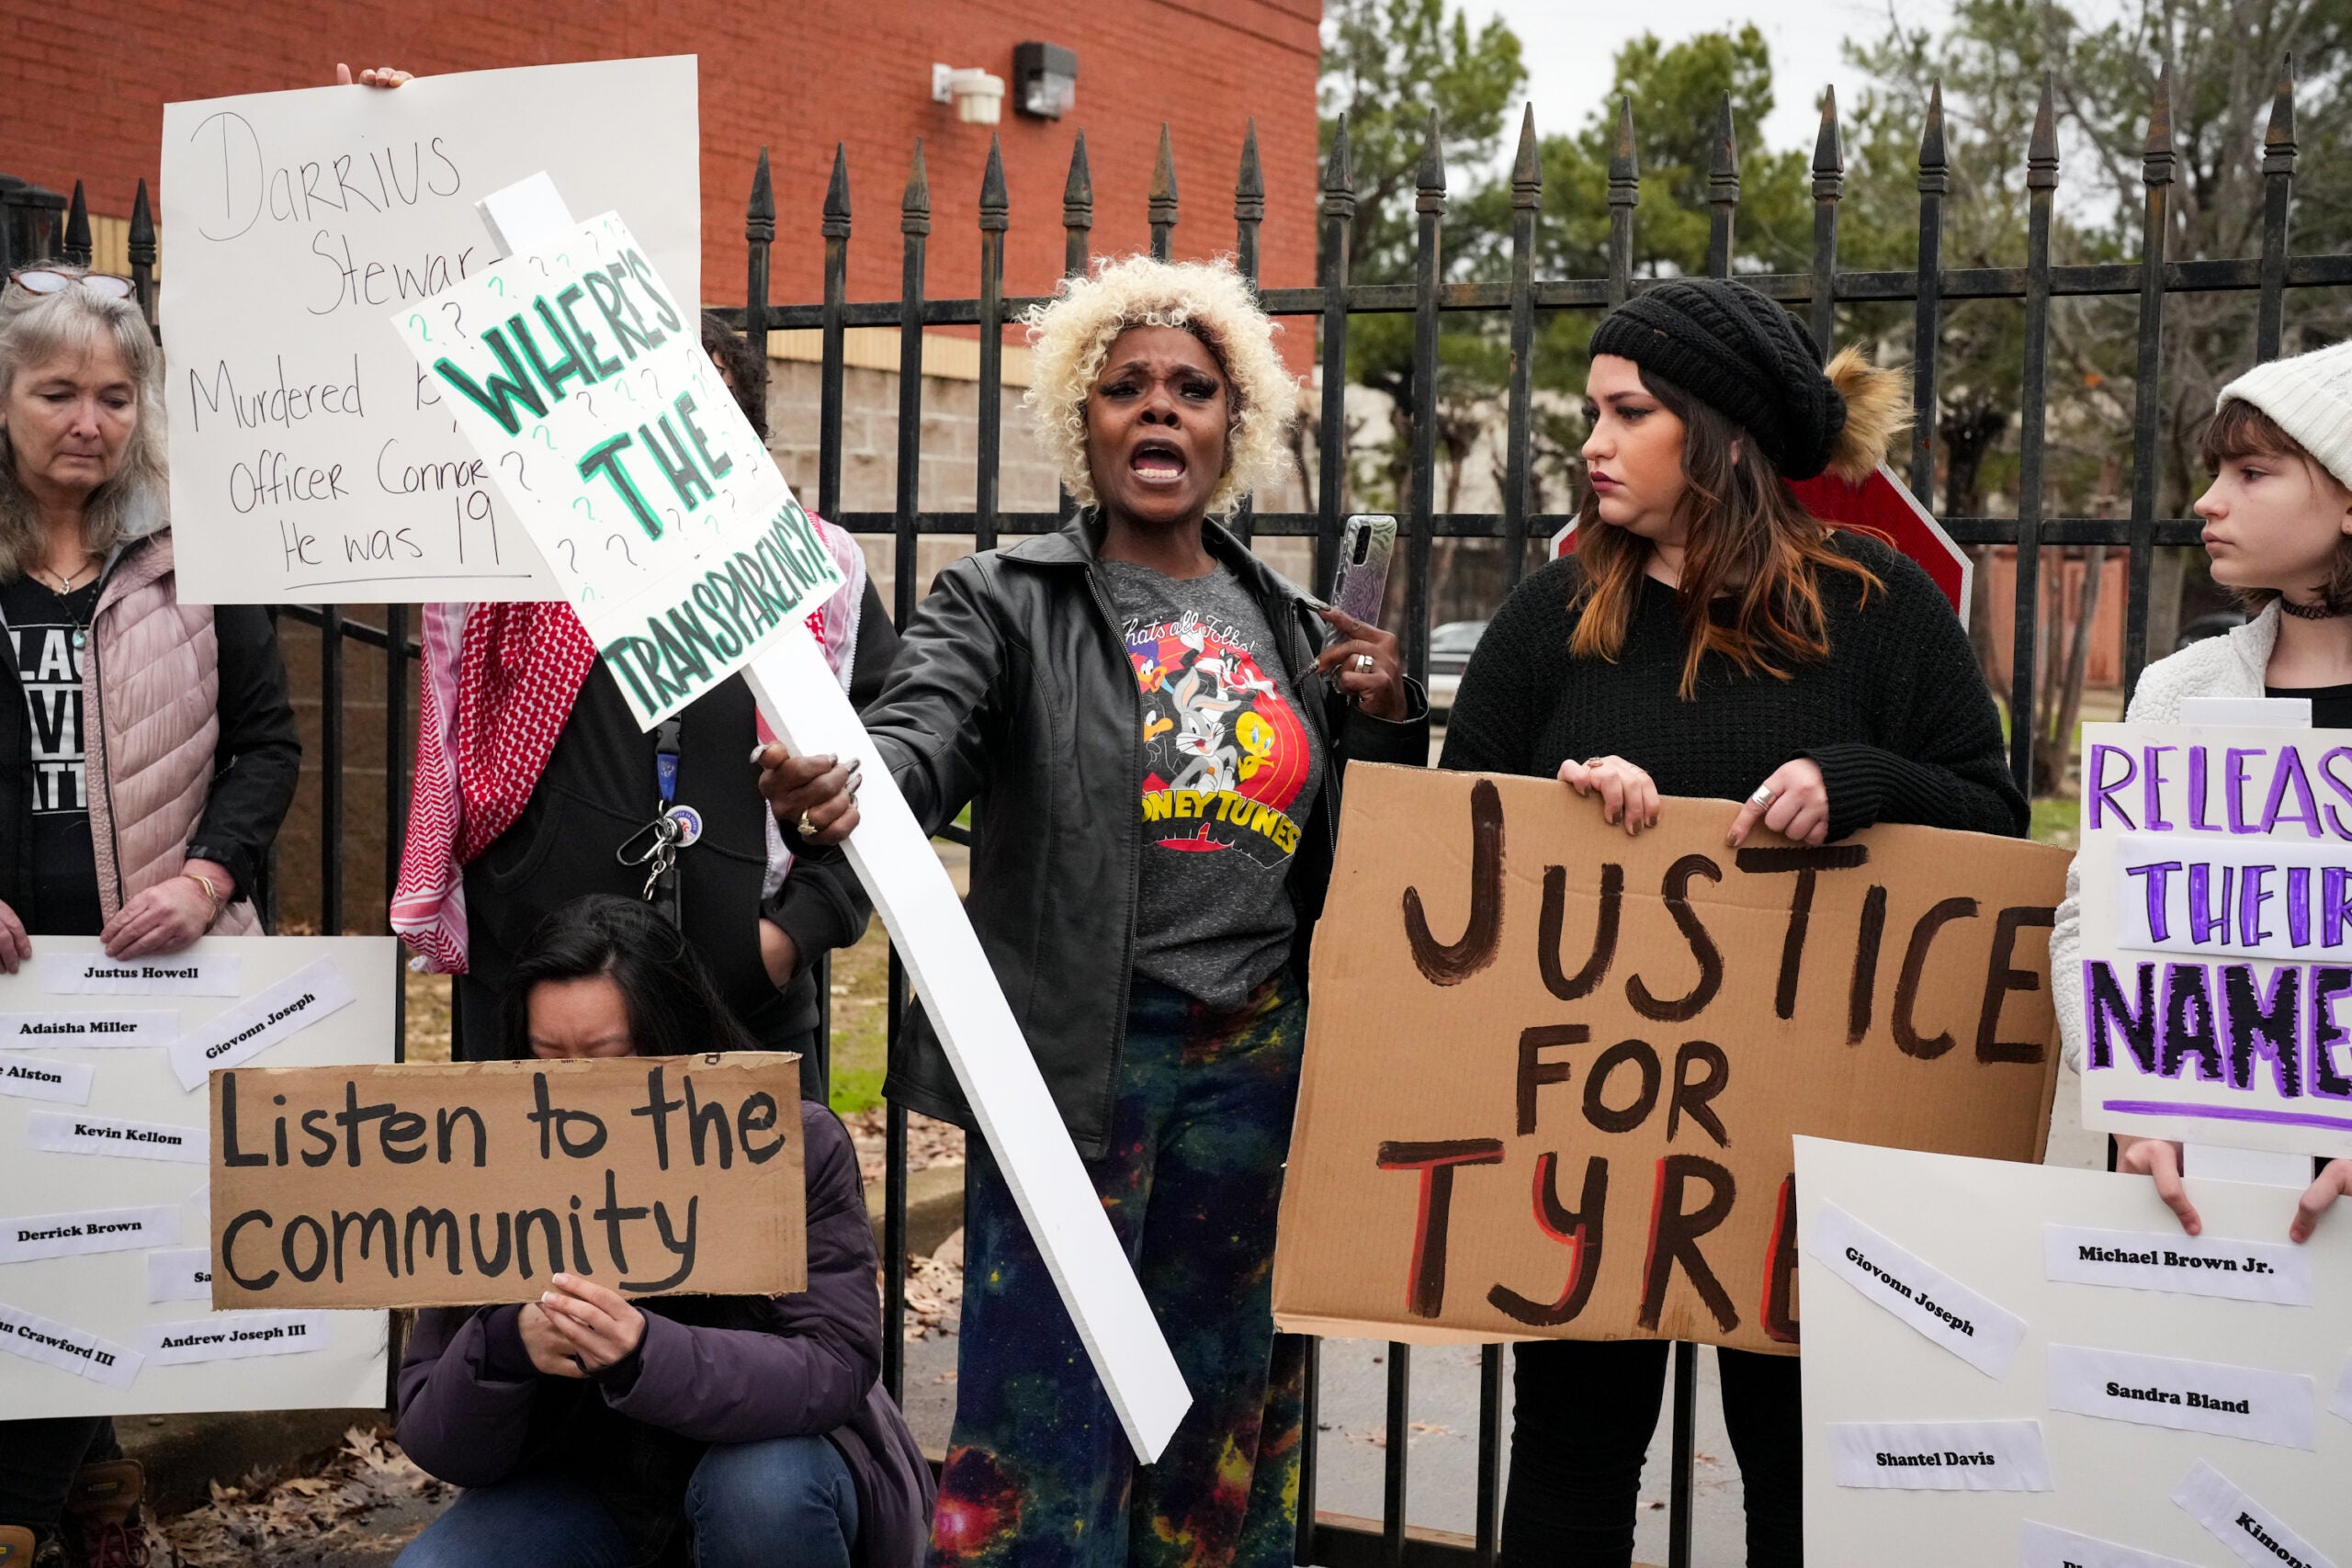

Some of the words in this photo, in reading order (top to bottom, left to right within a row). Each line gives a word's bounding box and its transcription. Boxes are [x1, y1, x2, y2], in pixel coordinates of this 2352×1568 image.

[432, 248, 682, 437] WHERE'S
[189, 352, 365, 433] Murdered
[575, 389, 734, 543] THE
[279, 519, 323, 573] He
[344, 526, 423, 563] was
[456, 490, 500, 566] 19
[601, 498, 840, 720] TRANSPARENCY?
[1216, 789, 1301, 854] TUNES
[1402, 779, 2057, 1064] JUSTICE
[83, 965, 140, 979] Justus
[141, 965, 199, 979] Howell
[18, 1021, 86, 1035] Adaisha
[89, 1021, 139, 1034] Miller
[205, 1022, 266, 1060] Giovonn
[266, 993, 317, 1026] Joseph
[6, 1066, 62, 1084] Alston
[1515, 1022, 1733, 1149] FOR
[74, 1122, 123, 1140] Kevin
[125, 1129, 184, 1146] Kellom
[222, 1071, 487, 1168] Listen
[526, 1071, 608, 1159] to
[631, 1066, 786, 1170] the
[17, 1224, 84, 1243] Derrick
[85, 1221, 143, 1236] Brown
[2077, 1245, 2160, 1267] Michael
[2163, 1250, 2239, 1272] Brown
[2241, 1257, 2276, 1275] Jr.
[1845, 1247, 1913, 1299] Giovonn
[1914, 1292, 1974, 1337] Joseph
[17, 1325, 94, 1359] Crawford
[94, 1349, 117, 1367] III
[160, 1333, 227, 1349] Andrew
[228, 1326, 285, 1343] Joseph
[287, 1323, 307, 1337] III
[2105, 1381, 2182, 1406] Sandra
[2185, 1391, 2251, 1416] Bland
[1874, 1451, 1942, 1468] Shantel
[1944, 1450, 1996, 1467] Davis
